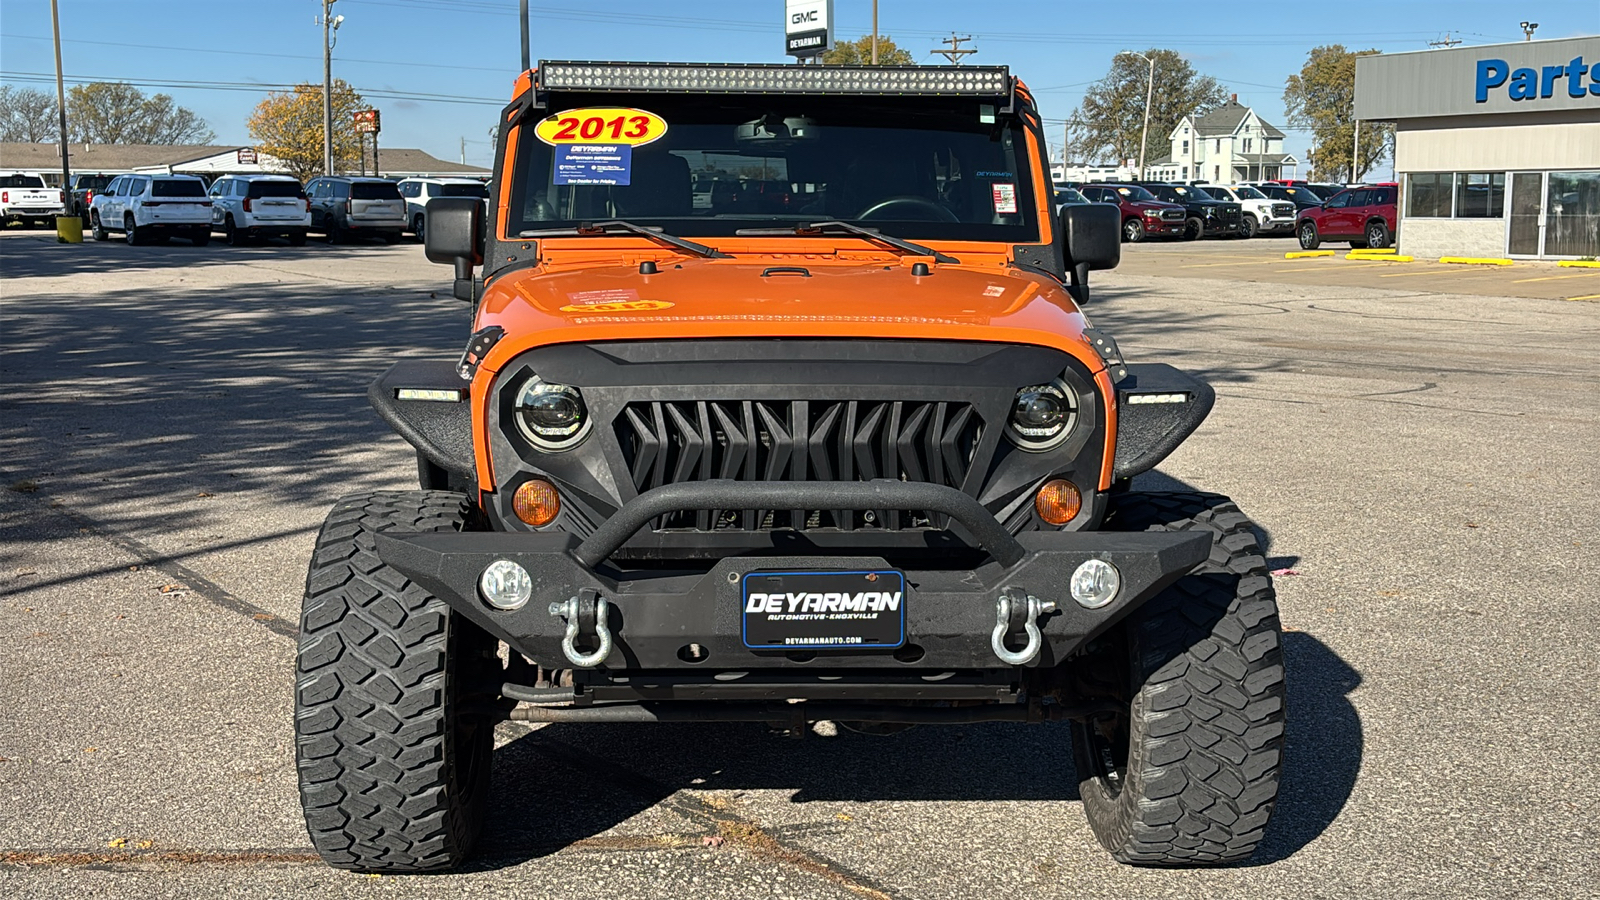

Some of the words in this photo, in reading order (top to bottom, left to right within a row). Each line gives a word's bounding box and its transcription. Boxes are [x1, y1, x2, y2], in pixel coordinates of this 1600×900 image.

[792, 10, 818, 24] GMC
[790, 36, 821, 49] DEYARMAN
[552, 116, 650, 140] 2013
[570, 145, 617, 153] DEYARMAN
[745, 591, 902, 613] DEYARMAN
[785, 636, 862, 645] DEYARMANAUTO.COM
